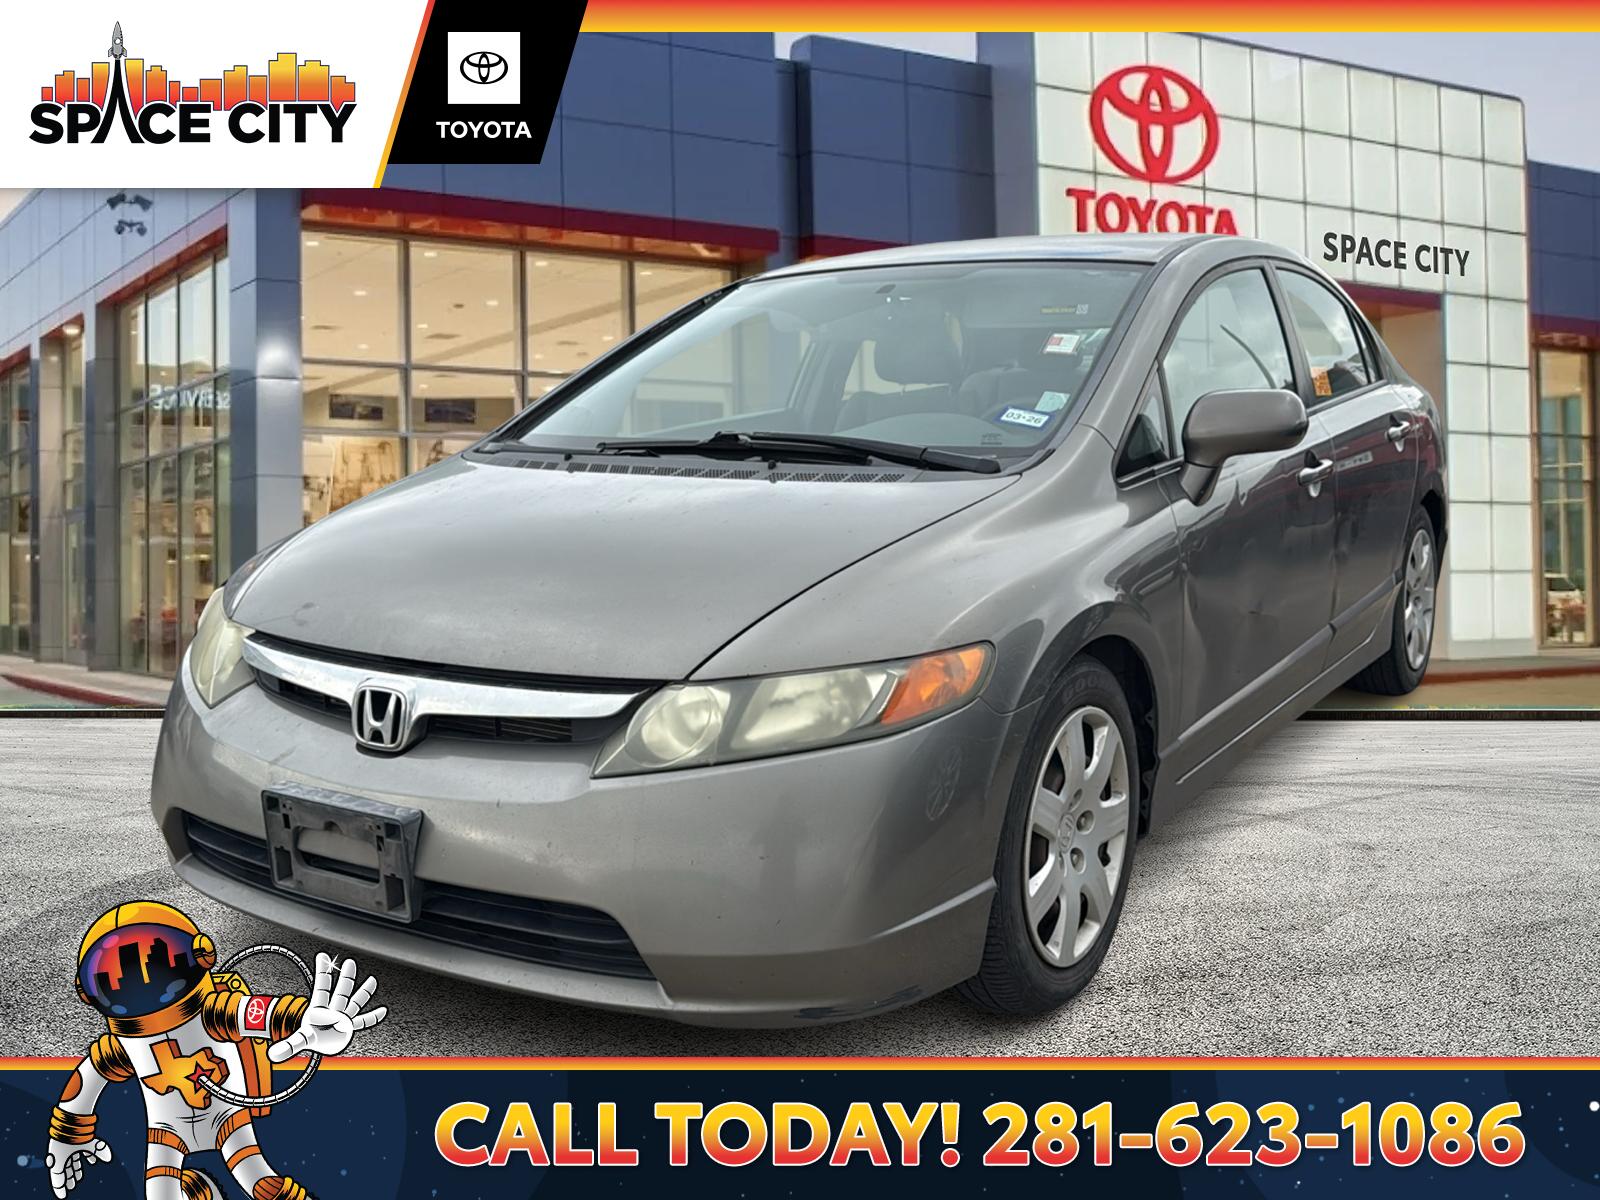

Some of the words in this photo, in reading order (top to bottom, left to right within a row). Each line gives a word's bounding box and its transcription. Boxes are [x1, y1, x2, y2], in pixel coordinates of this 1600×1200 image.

[1065, 187, 1239, 236] TOYOTA
[1323, 232, 1407, 270] SPACE
[1415, 244, 1470, 277] CITY
